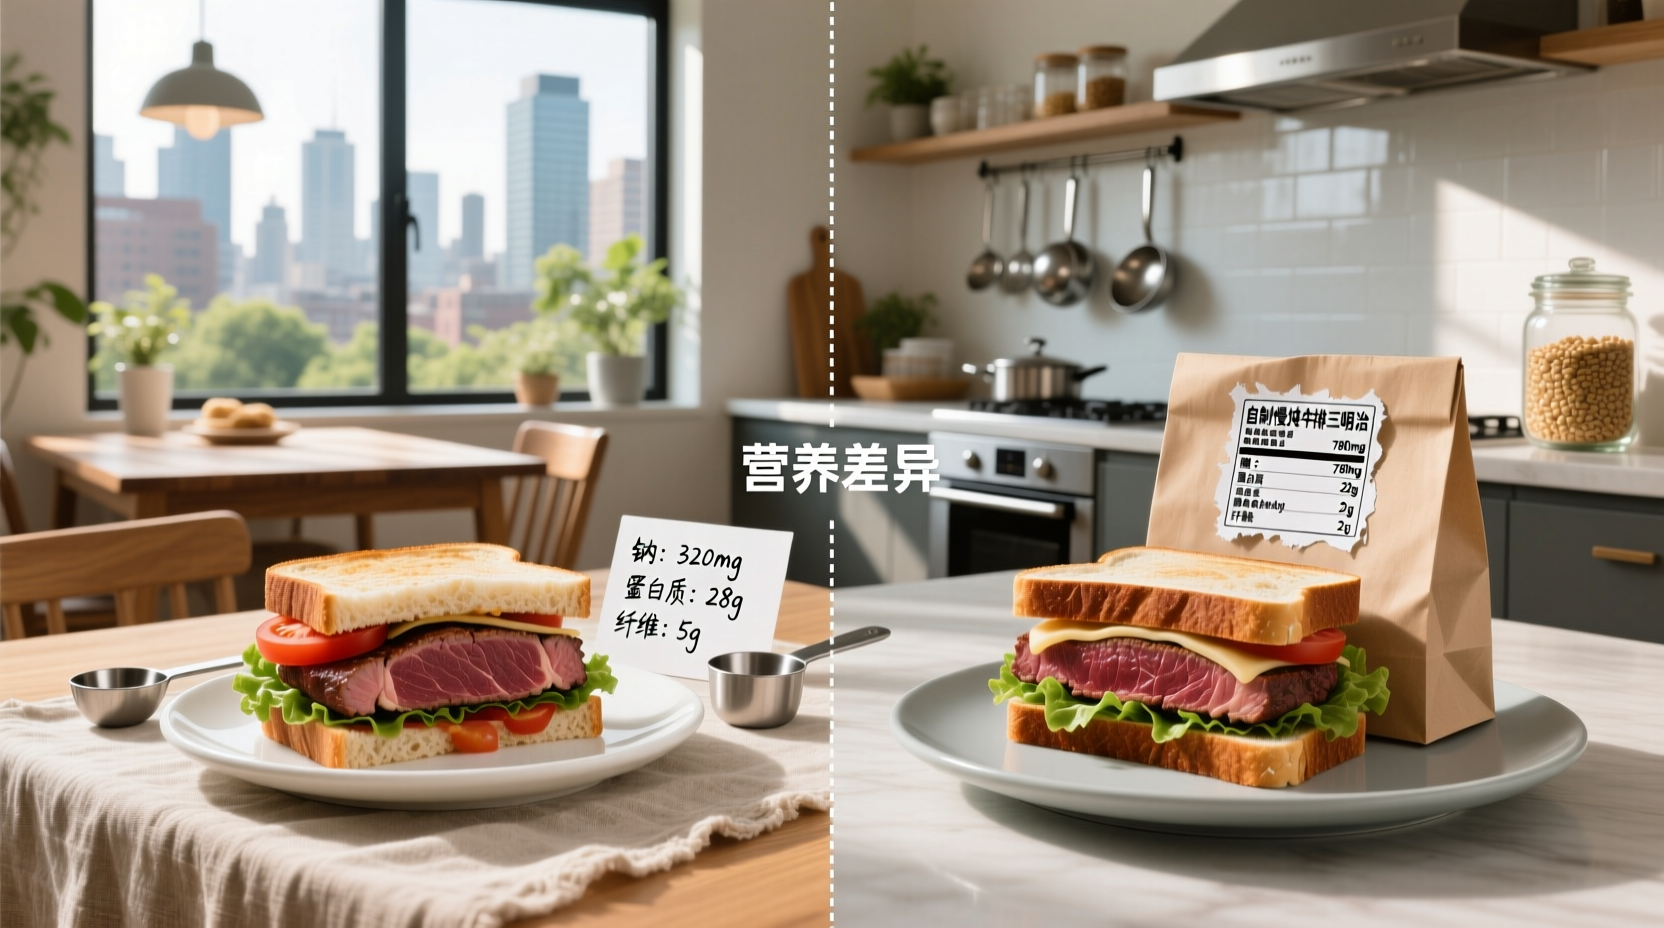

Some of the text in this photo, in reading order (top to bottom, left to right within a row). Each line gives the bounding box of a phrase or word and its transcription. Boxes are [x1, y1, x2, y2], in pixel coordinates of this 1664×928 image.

[1332, 440, 1366, 454] 780mg
[632, 537, 743, 582] 钠： 320mg
[705, 587, 744, 621] 28g
[614, 610, 701, 654] 纤维： 5g
